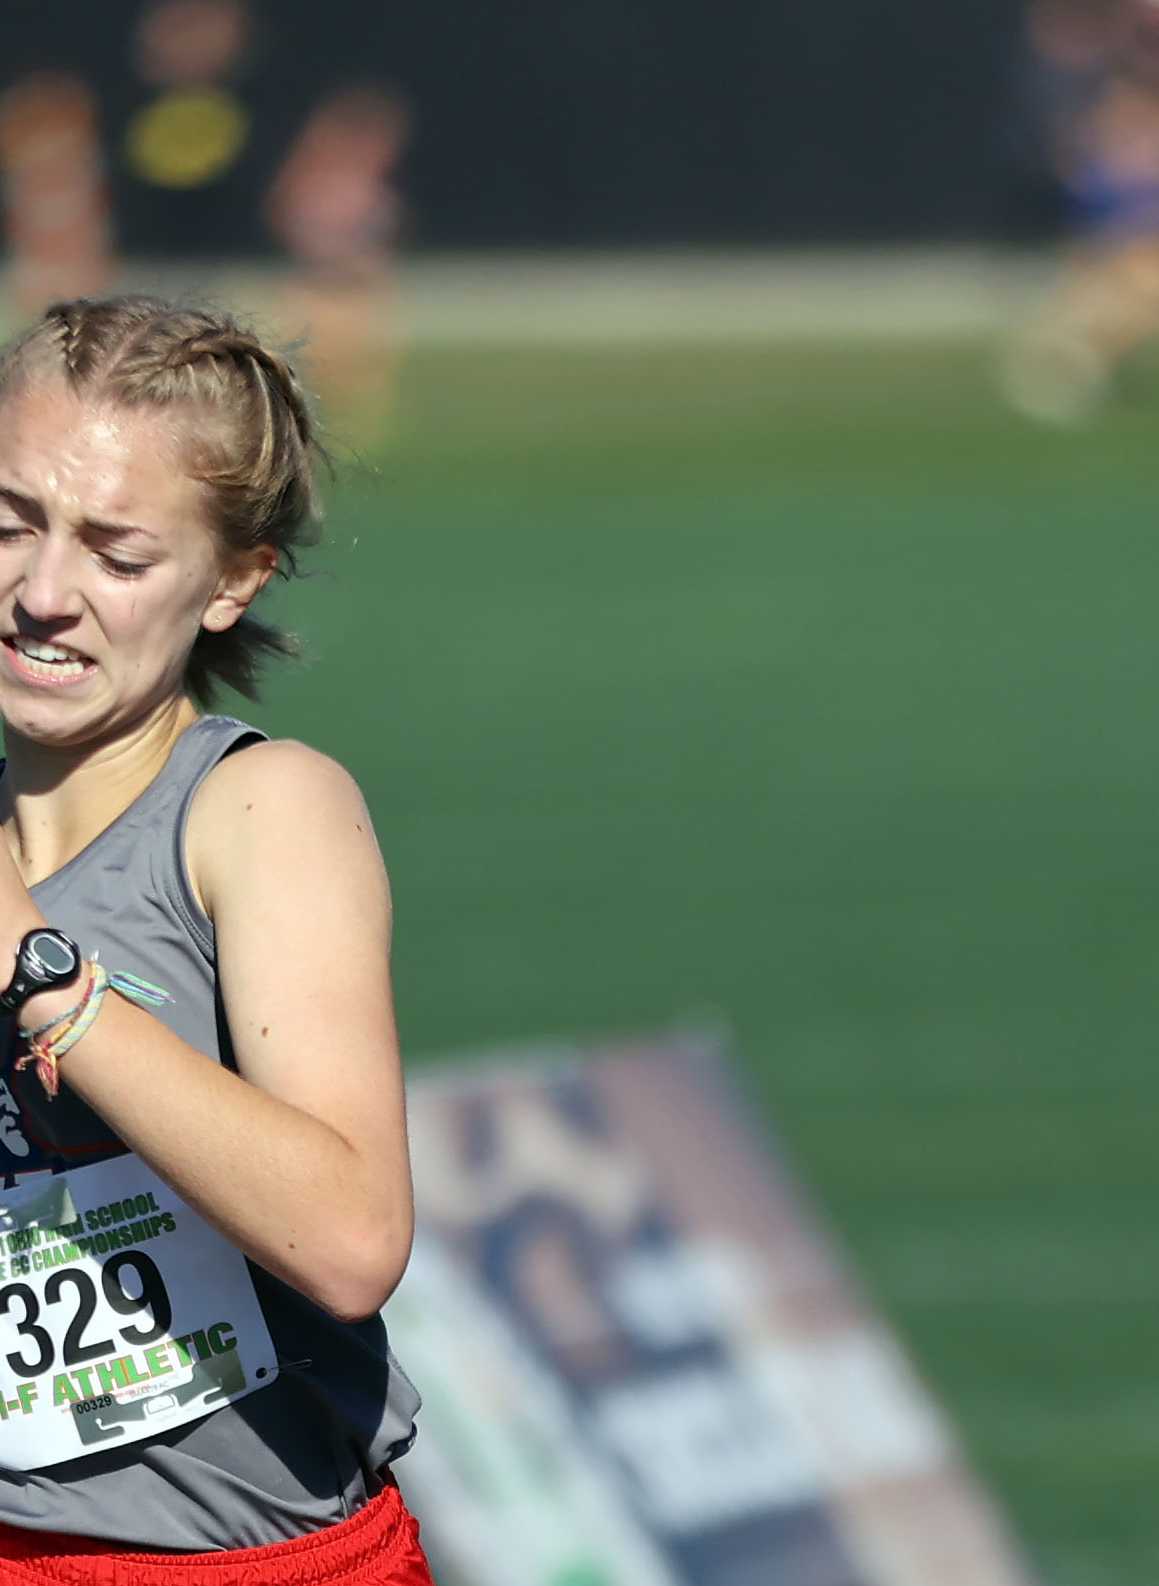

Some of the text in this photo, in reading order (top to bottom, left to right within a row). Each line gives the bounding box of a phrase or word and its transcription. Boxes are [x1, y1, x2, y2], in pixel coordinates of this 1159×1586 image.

[85, 1192, 160, 1230] SCHOOL
[10, 1254, 31, 1278] CC
[32, 1212, 177, 1272] CHAMPIONSHIPS
[53, 1322, 237, 1407] ATHLETIC
[76, 1396, 112, 1414] 00329
